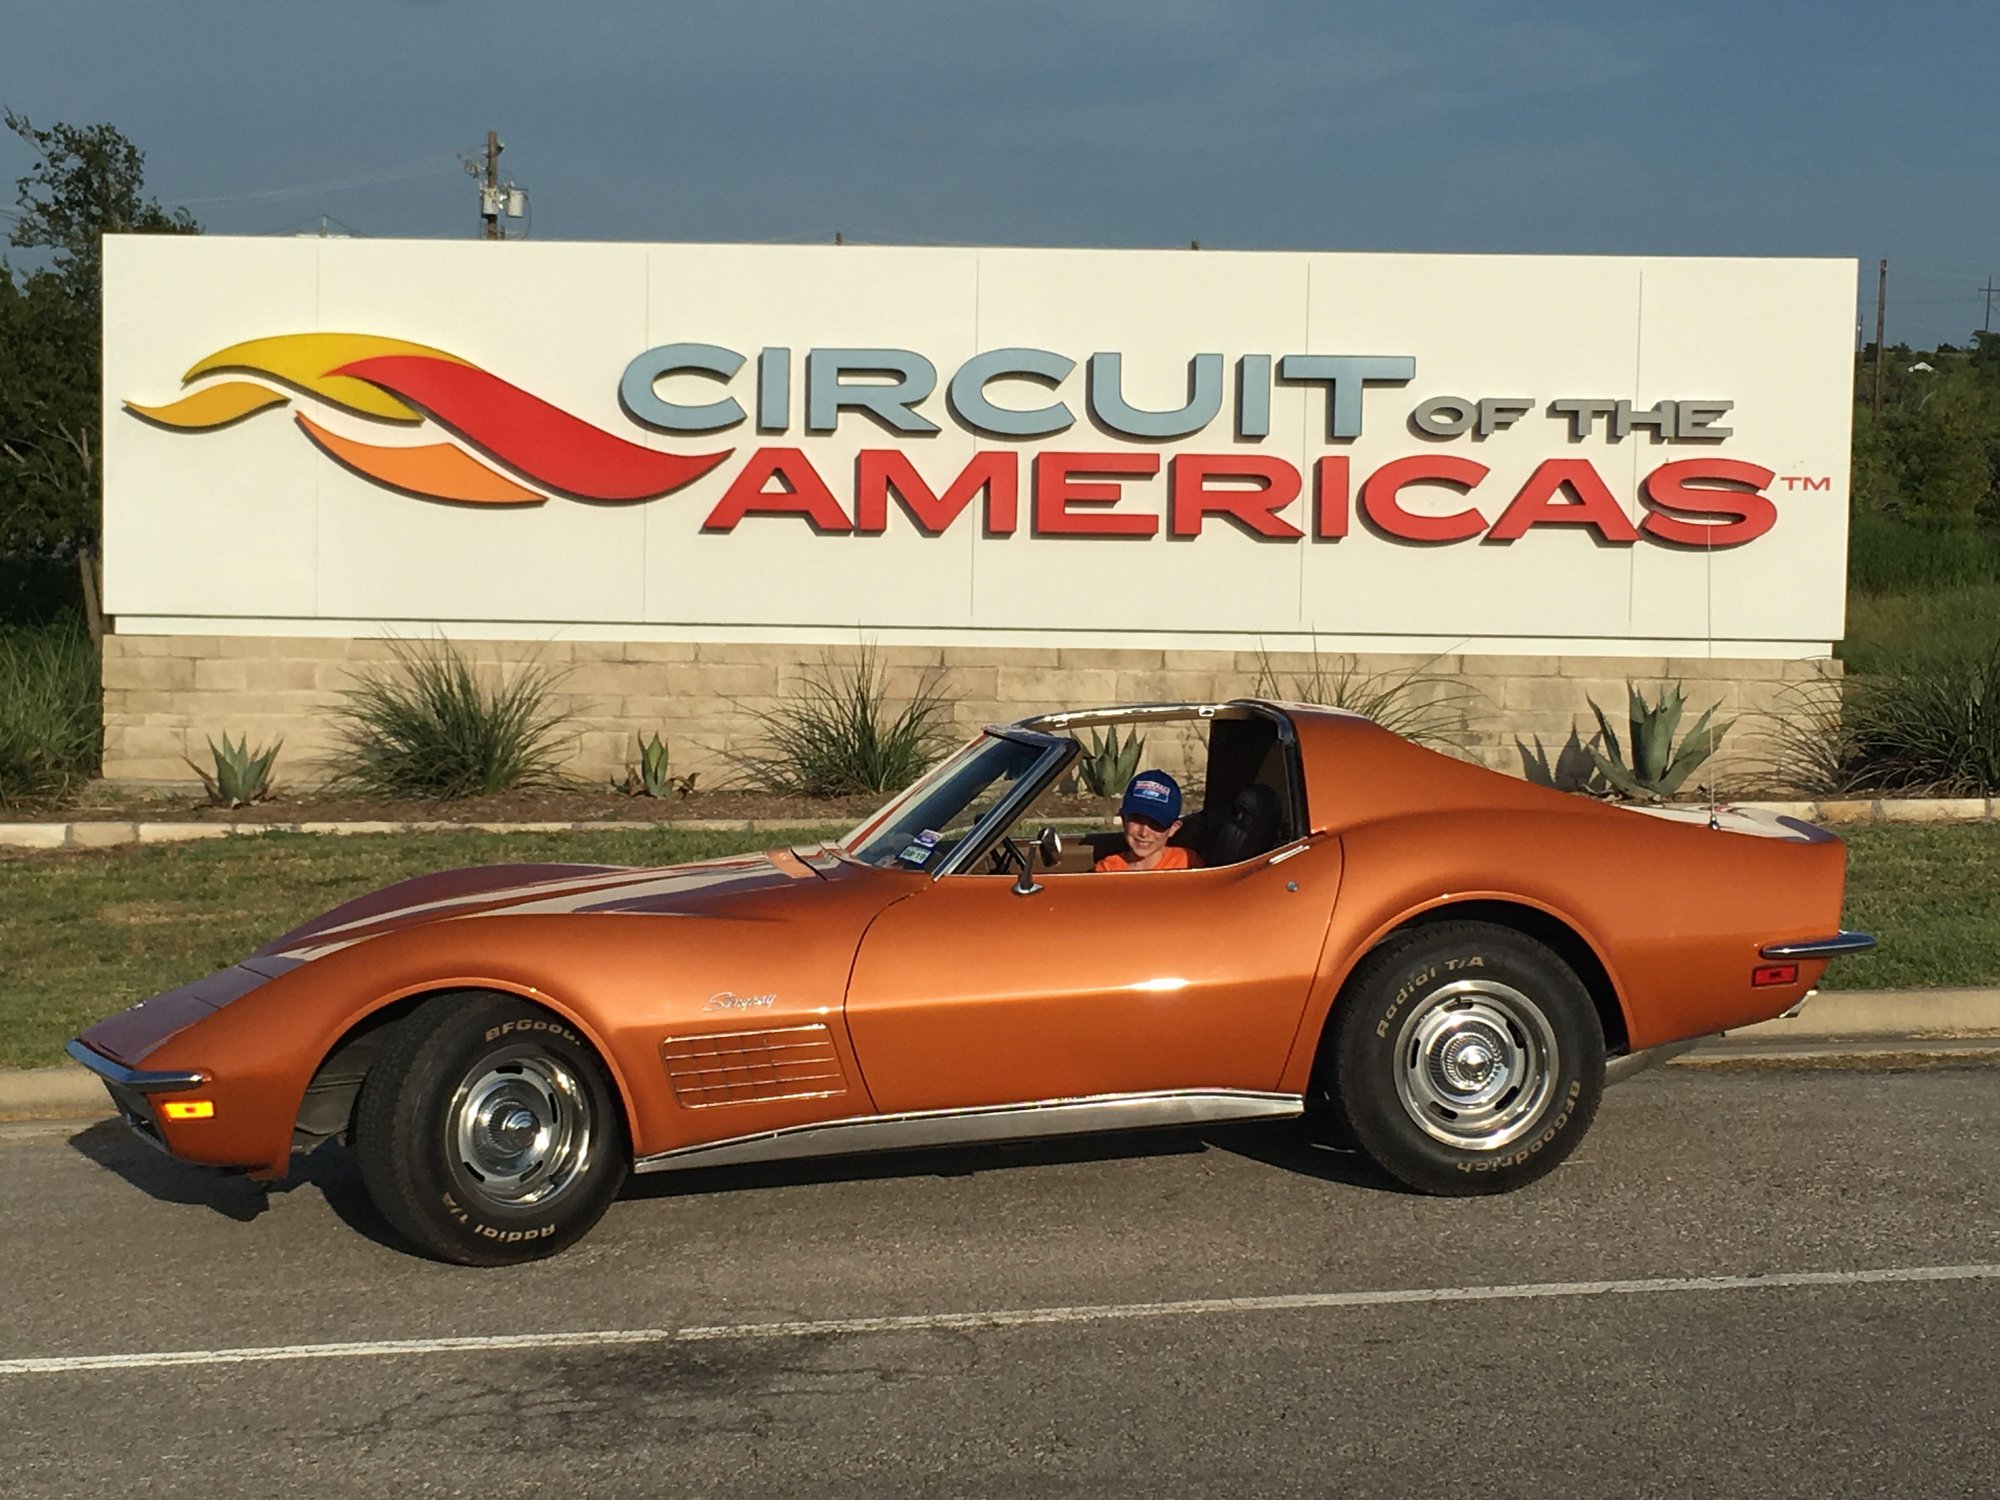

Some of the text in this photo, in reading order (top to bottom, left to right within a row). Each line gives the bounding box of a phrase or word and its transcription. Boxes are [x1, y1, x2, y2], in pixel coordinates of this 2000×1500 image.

[619, 343, 1734, 445] CIRCUIT OF THE
[701, 447, 1777, 550] AMERICAS
[1376, 955, 1484, 1038] Radial T/A
[1457, 1080, 1581, 1173] BFGoodrich
[474, 1223, 556, 1243] Radial
